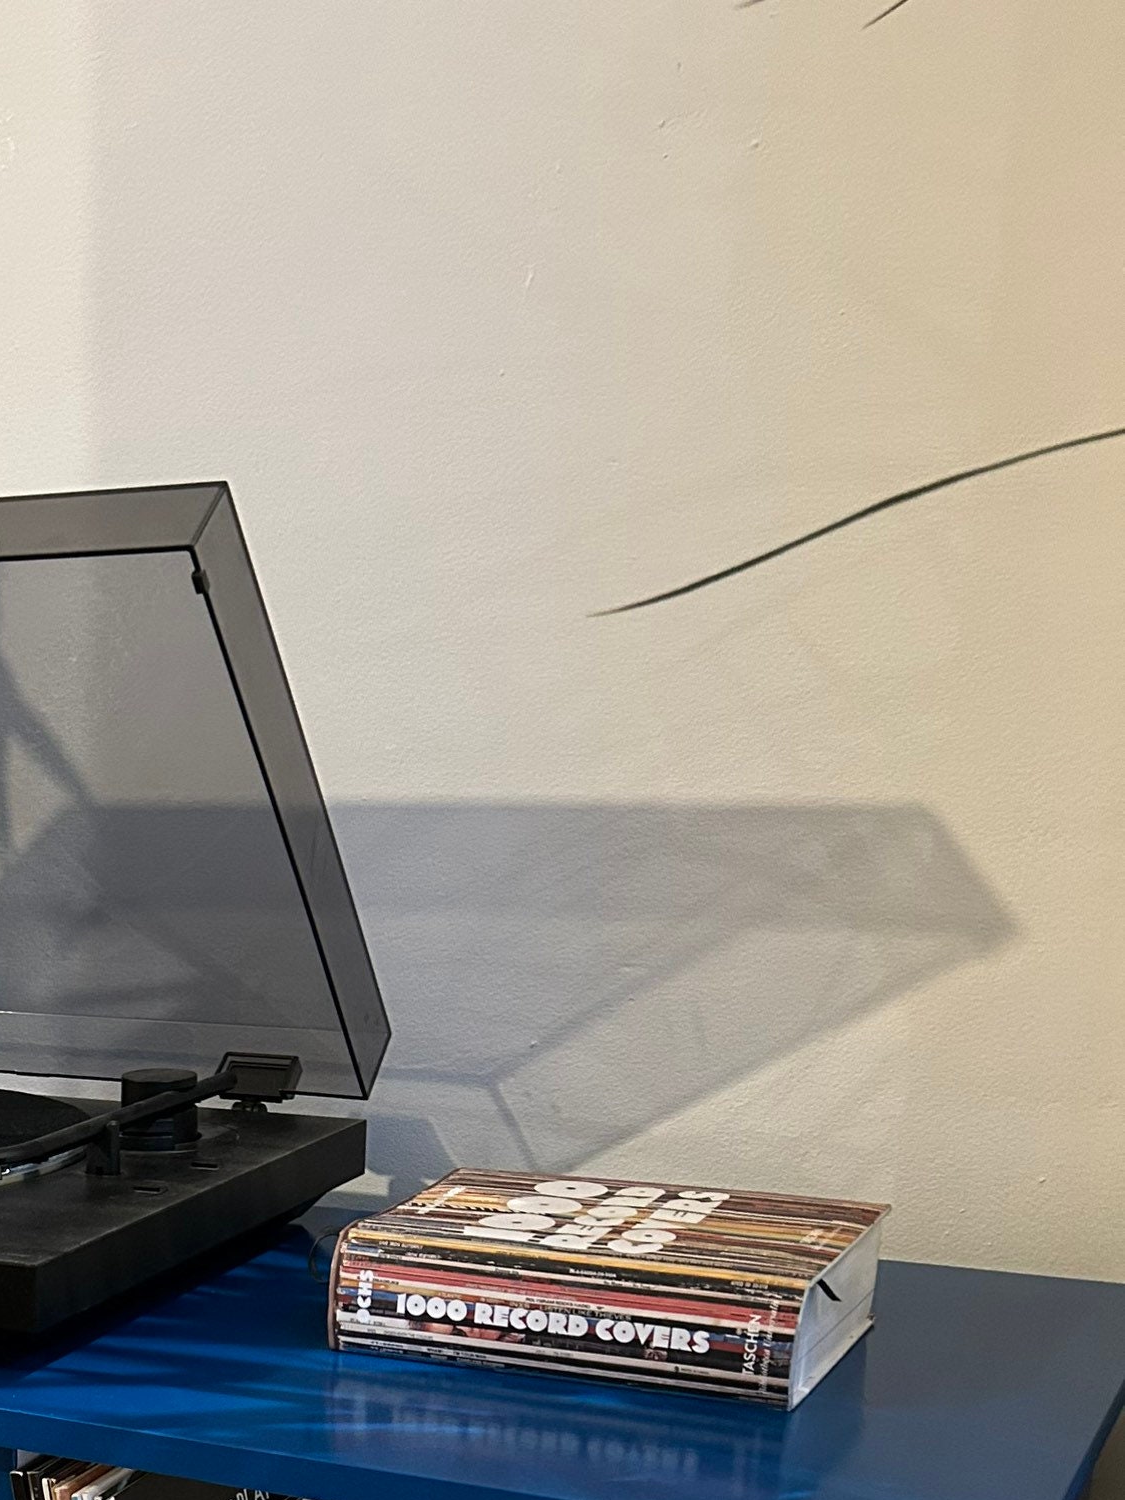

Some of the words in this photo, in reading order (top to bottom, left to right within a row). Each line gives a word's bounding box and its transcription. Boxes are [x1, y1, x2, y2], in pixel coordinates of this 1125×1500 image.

[463, 1180, 609, 1244] 1000
[539, 1186, 666, 1250] RECORD
[607, 1190, 731, 1254] COVERS
[396, 1293, 468, 1322] 1000
[473, 1302, 589, 1337] RECORD
[594, 1319, 710, 1354] COVERS
[741, 1314, 762, 1375] TASCHEN
